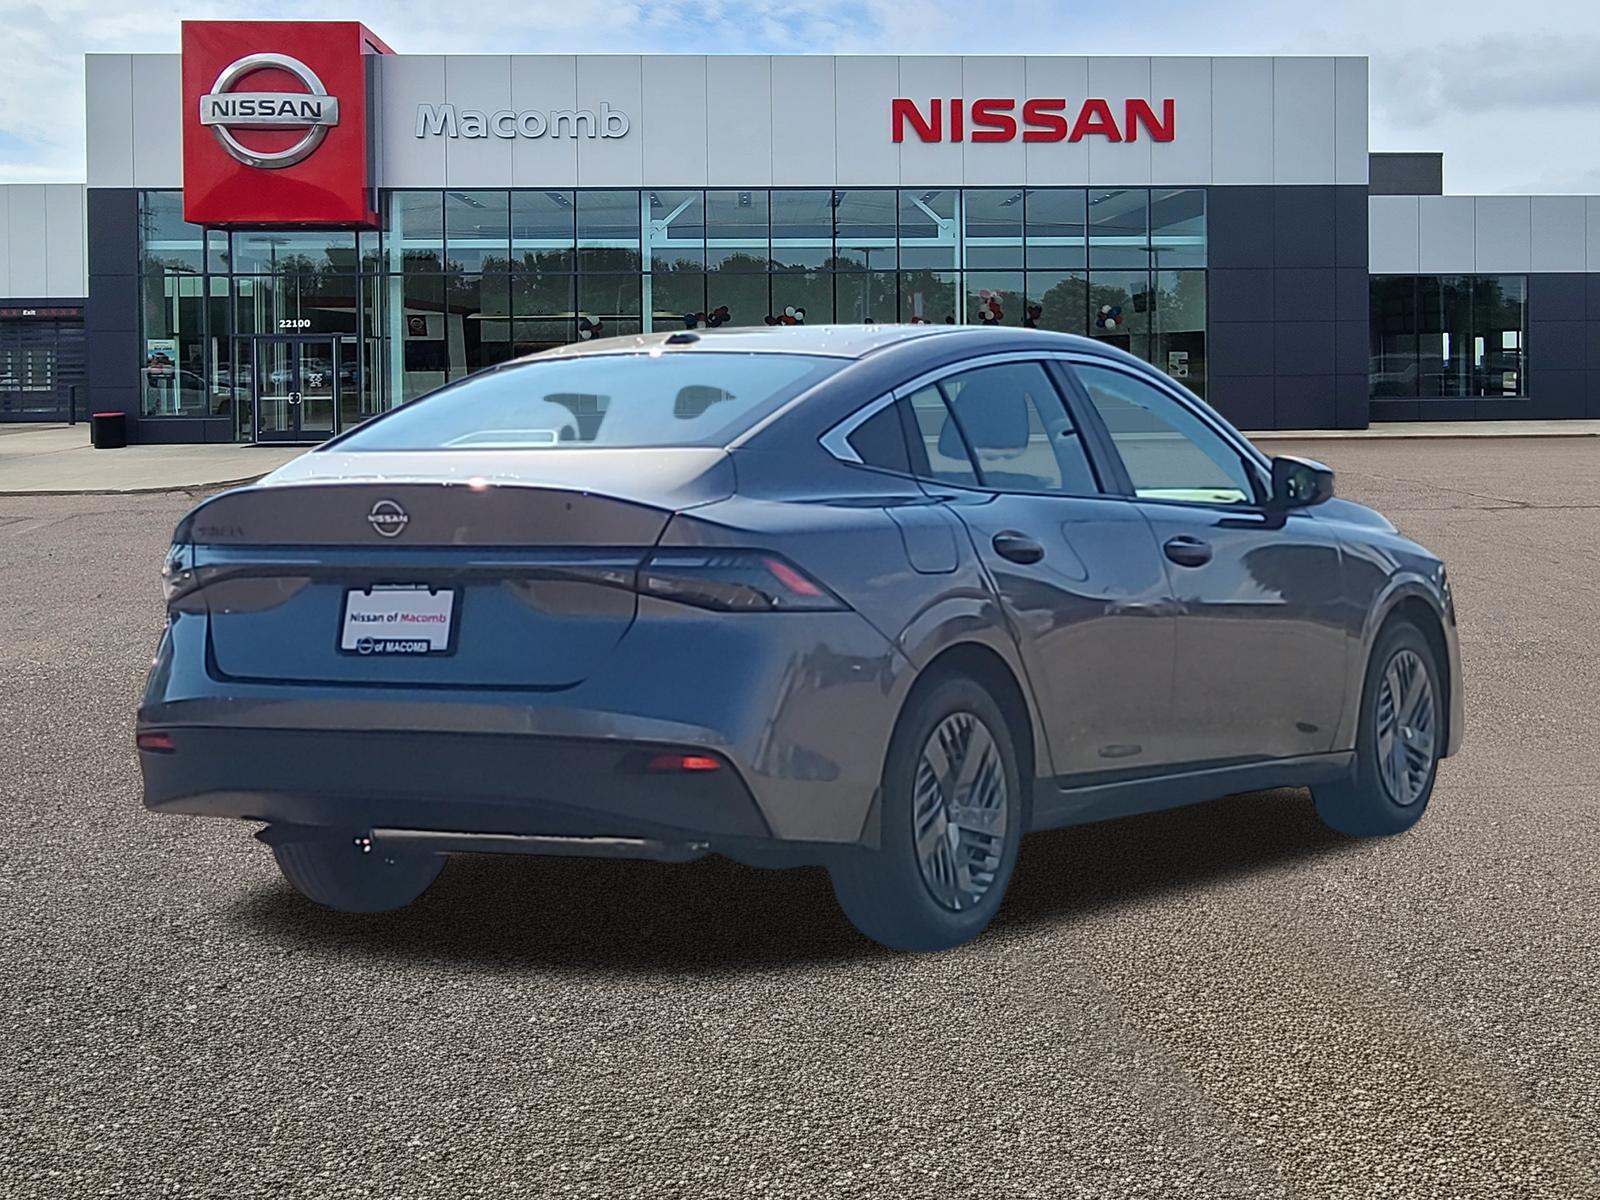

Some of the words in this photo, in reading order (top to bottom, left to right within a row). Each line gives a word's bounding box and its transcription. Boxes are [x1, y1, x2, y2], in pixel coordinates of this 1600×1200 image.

[212, 100, 322, 118] NISSAN
[415, 102, 630, 139] Macomb
[891, 98, 1175, 143] NISSAN
[279, 319, 311, 328] 22100
[367, 514, 408, 523] NISSAN
[350, 612, 385, 623] Nissan
[386, 612, 399, 623] of
[400, 612, 447, 623] Macomb
[374, 641, 385, 653] of
[385, 641, 429, 653] MACOMB
